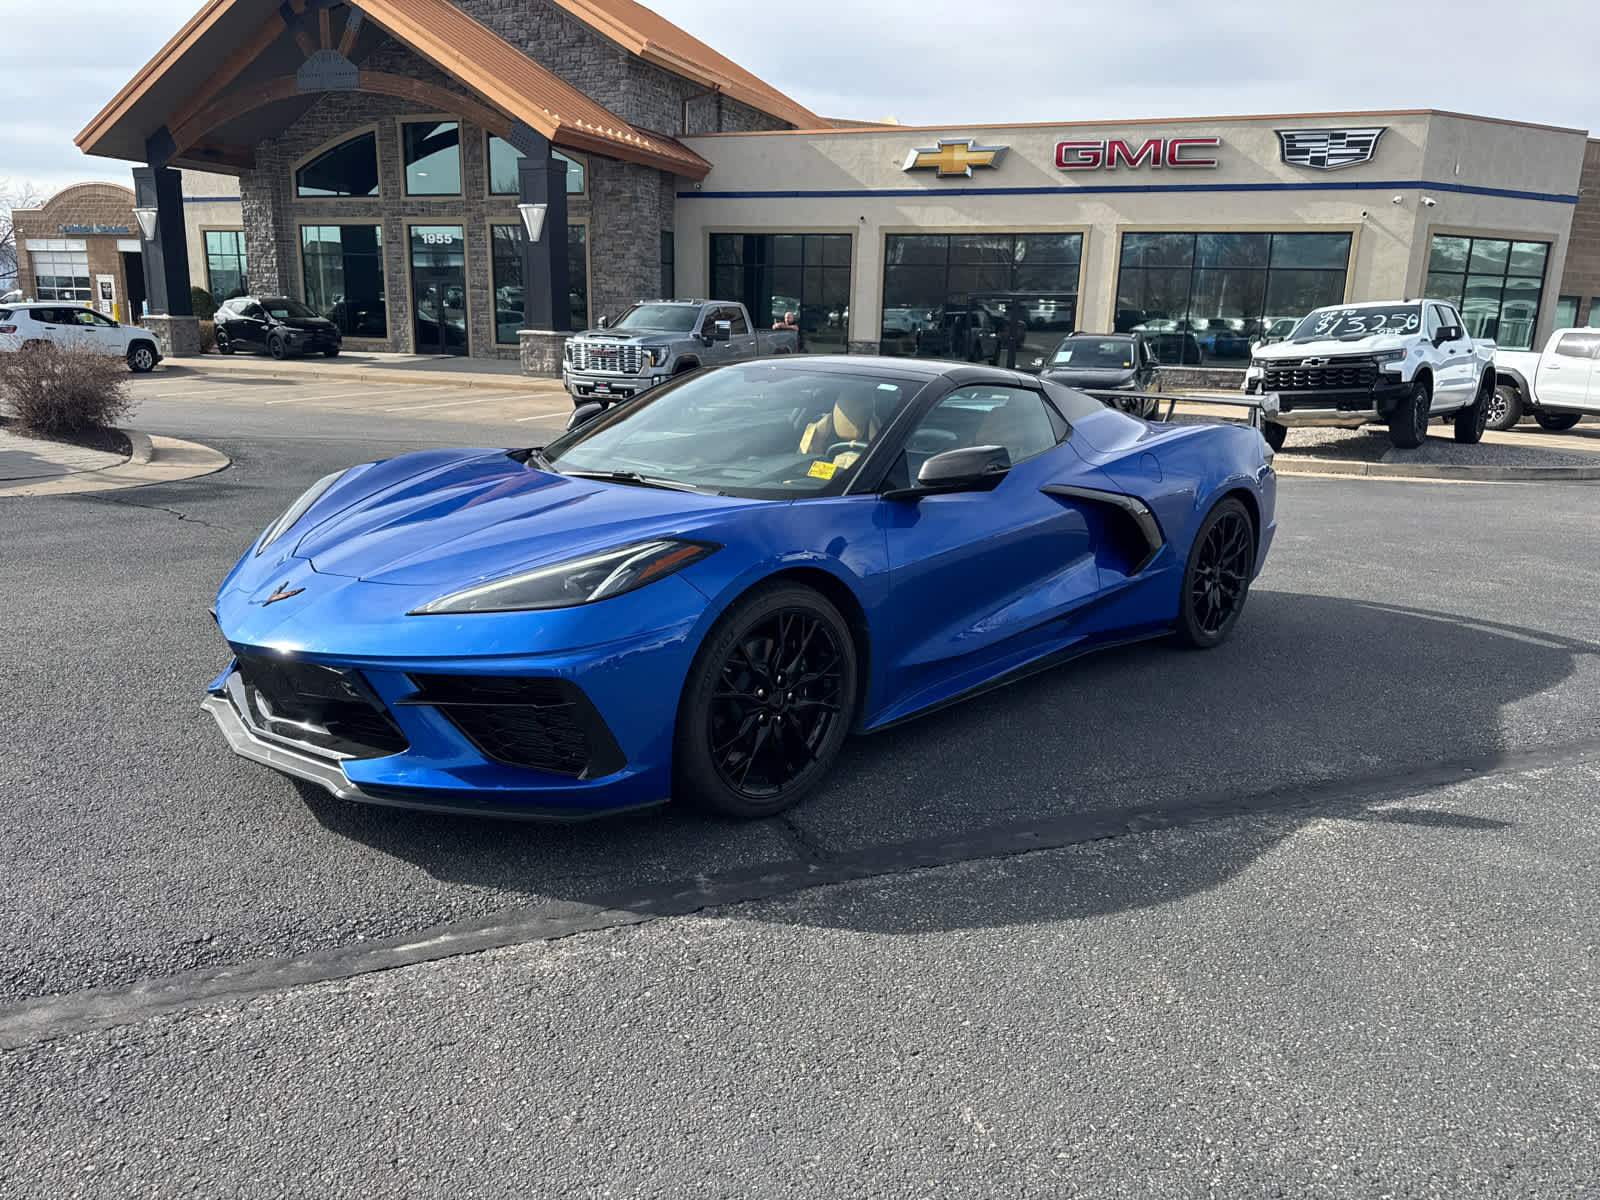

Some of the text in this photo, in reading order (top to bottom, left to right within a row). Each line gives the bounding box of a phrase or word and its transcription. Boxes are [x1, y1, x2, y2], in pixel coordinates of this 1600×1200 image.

[1055, 137, 1220, 169] GMC
[422, 233, 453, 244] 1955
[1320, 309, 1357, 320] UP TO
[1376, 327, 1404, 335] OFF
